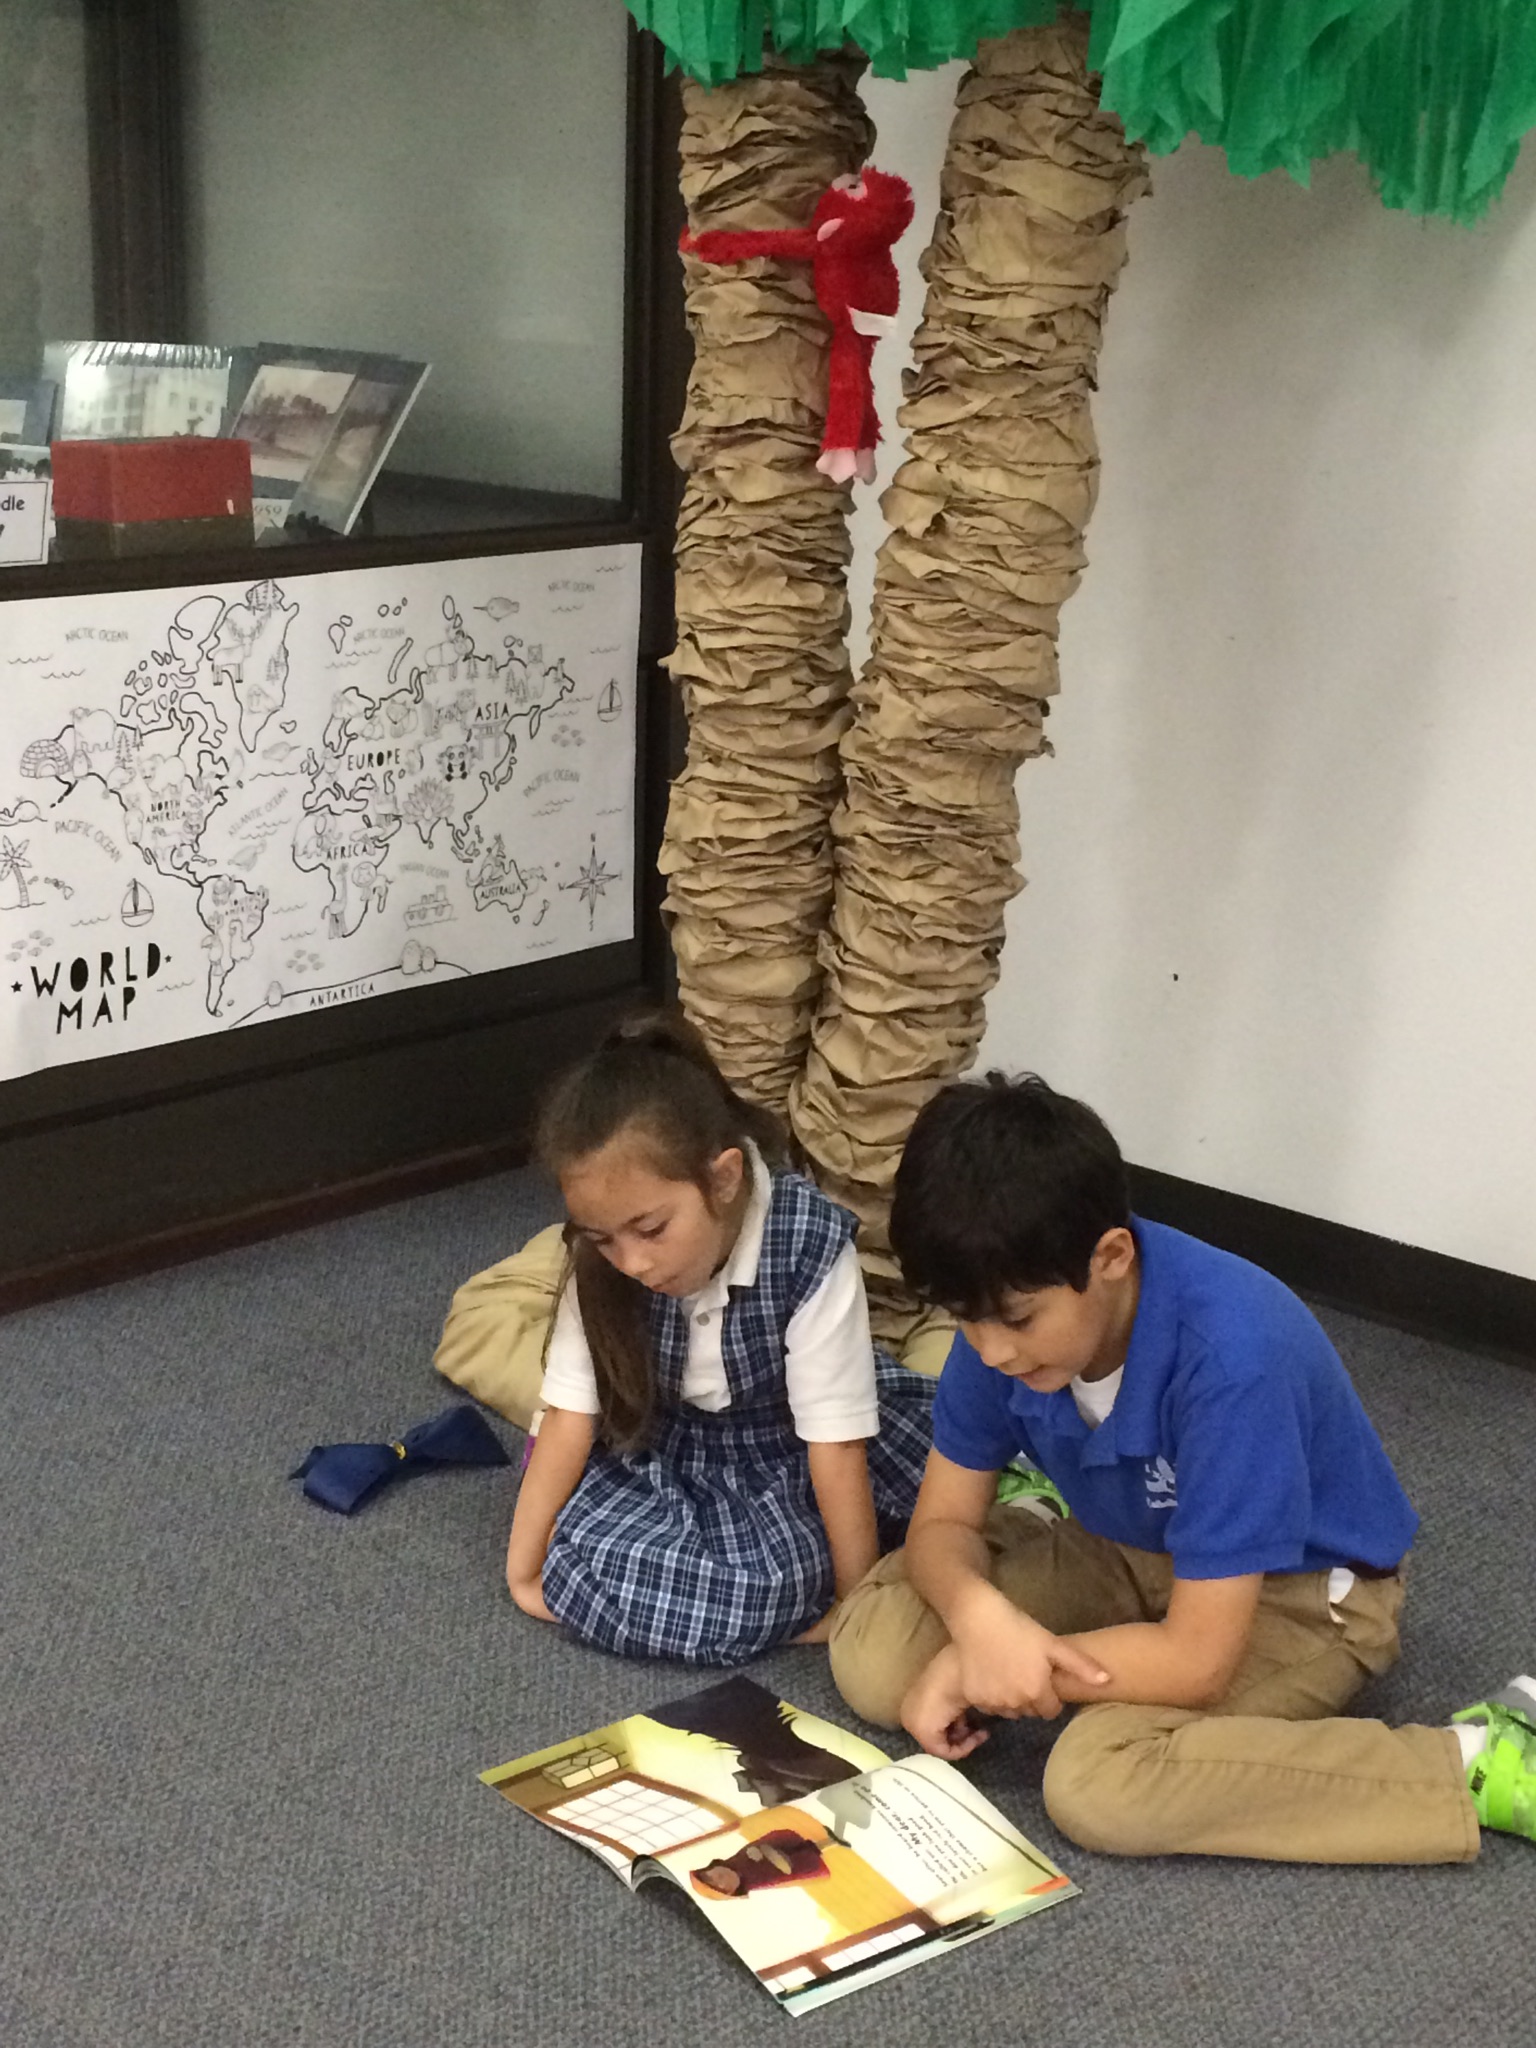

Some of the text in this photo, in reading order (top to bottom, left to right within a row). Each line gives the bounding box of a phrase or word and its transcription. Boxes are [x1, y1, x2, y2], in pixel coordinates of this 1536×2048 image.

[65, 627, 129, 643] ARCTIC OCEAN
[474, 702, 510, 722] ASIA
[348, 748, 401, 771] EUROPE
[151, 800, 181, 812] NORTH
[228, 787, 288, 836] ATLANTIC OCEAN
[146, 811, 187, 823] AMERICA
[55, 818, 122, 862] PACIFIC OCEAN
[327, 844, 368, 861] AFRICA
[481, 883, 520, 900] AUSTRALIA
[31, 942, 161, 999] WORLD
[309, 983, 375, 1007] ANTARTICA
[56, 986, 136, 1034] MAP
